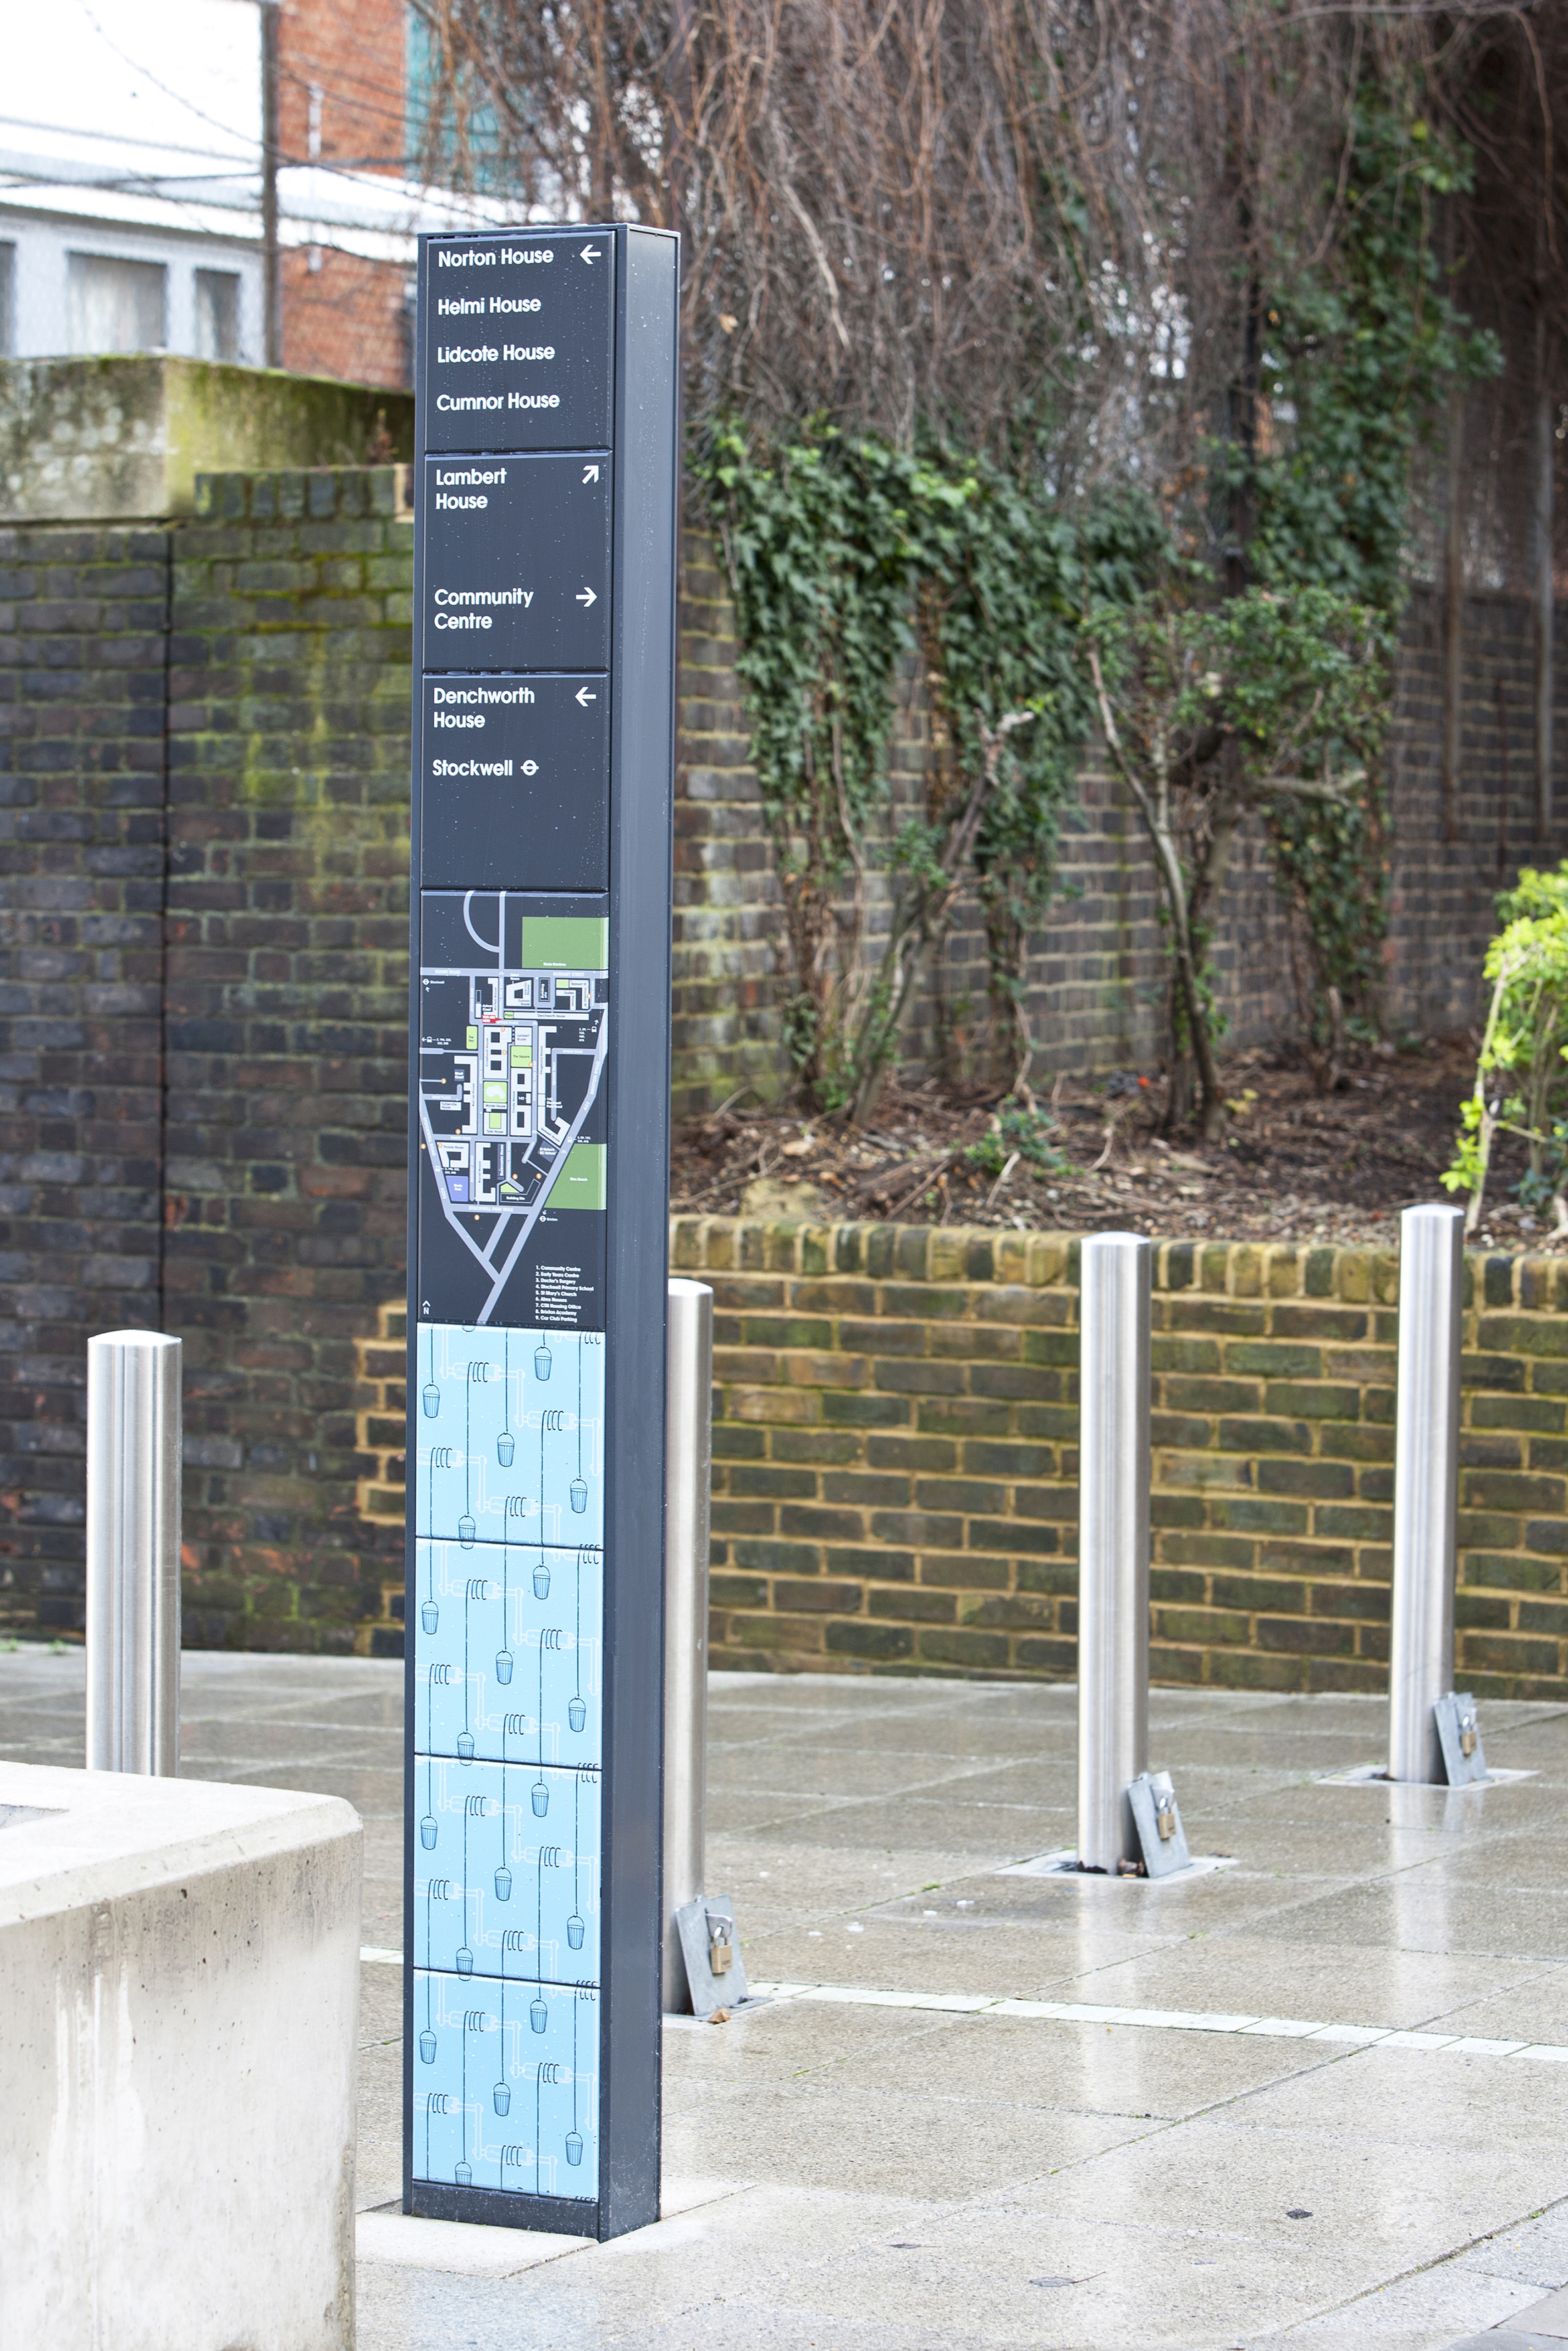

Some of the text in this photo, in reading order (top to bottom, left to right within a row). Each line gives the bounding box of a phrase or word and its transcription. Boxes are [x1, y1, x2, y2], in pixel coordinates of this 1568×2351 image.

[438, 248, 554, 268] Norton House
[437, 296, 542, 315] Helmi House
[437, 344, 556, 363] Lidcote House
[436, 392, 560, 411] Cumnor House
[436, 467, 507, 486] Lambert
[435, 493, 489, 510] House
[434, 588, 534, 608] Community
[434, 612, 493, 629] Centre
[433, 687, 535, 704] Denchworth
[433, 711, 486, 728] House
[432, 759, 513, 777] Stockwell
[422, 1117, 433, 1143] STOCKWELL
